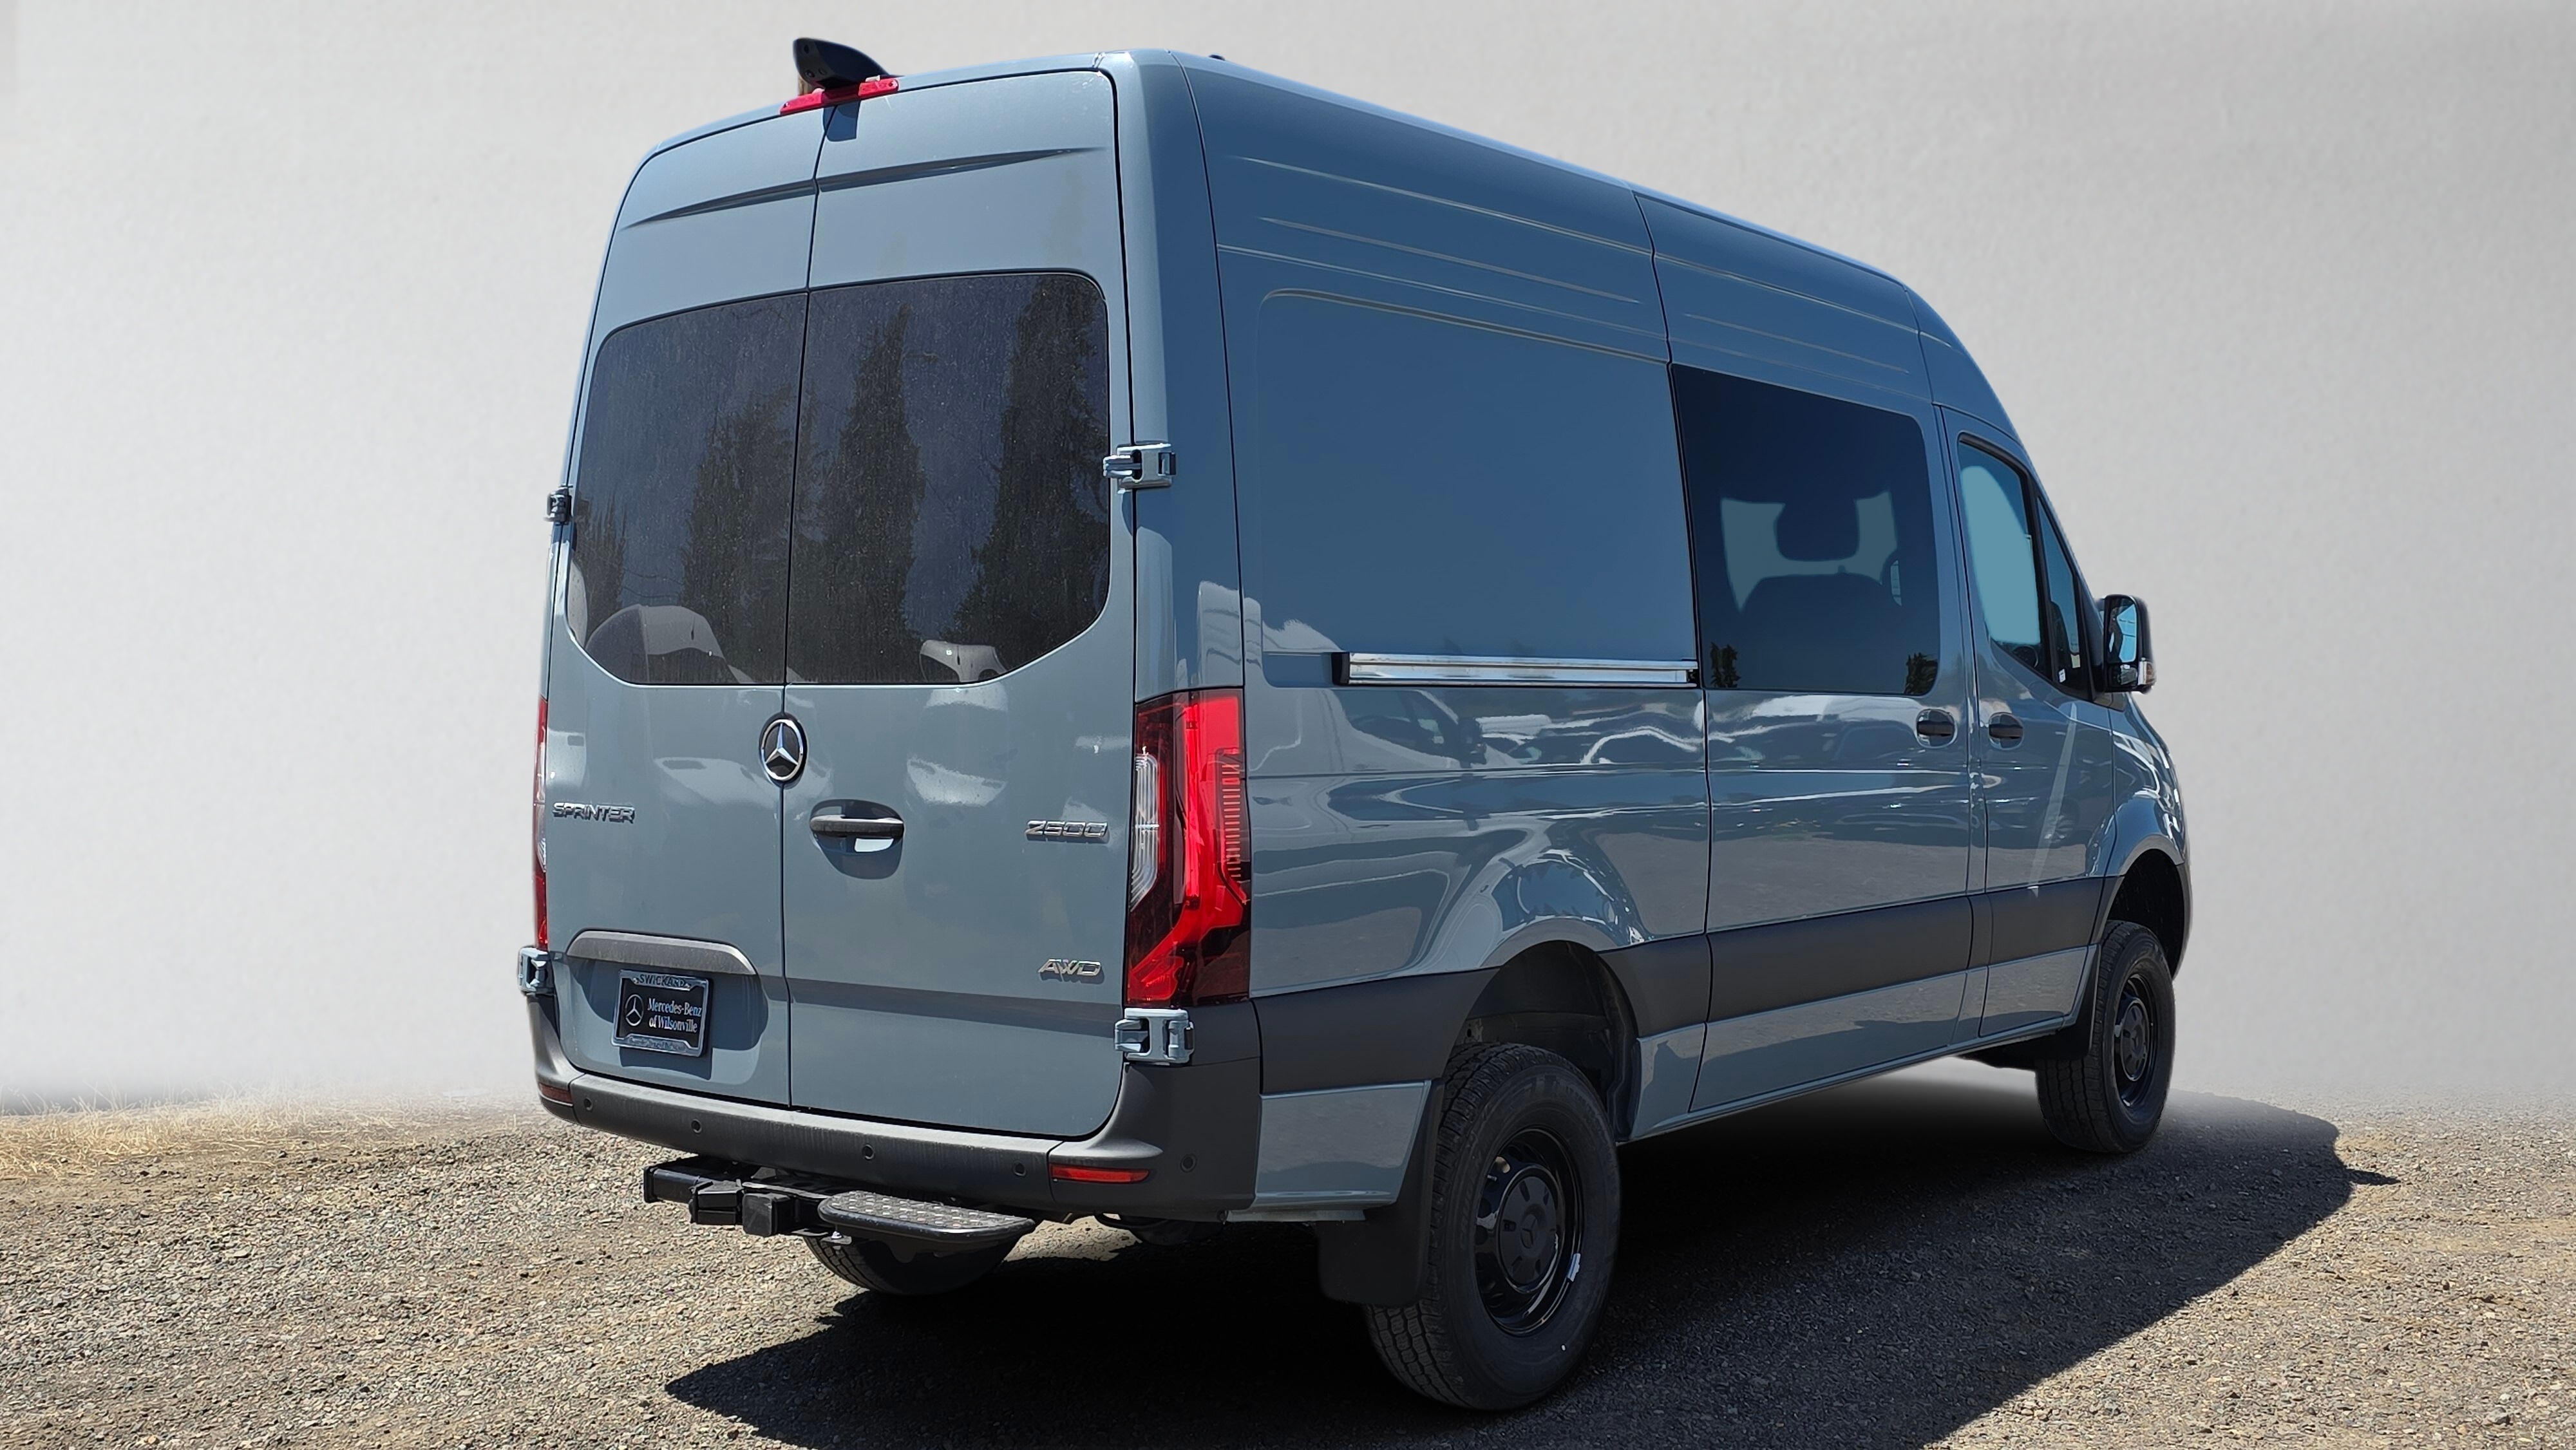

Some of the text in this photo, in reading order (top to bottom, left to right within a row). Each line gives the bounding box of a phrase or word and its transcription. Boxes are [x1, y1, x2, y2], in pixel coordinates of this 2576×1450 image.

[553, 802, 635, 822] SPRINTER
[1025, 820, 1108, 838] 2500
[1037, 959, 1101, 976] AWD
[638, 974, 685, 987] SWICKARD
[647, 997, 702, 1017] Mercedes-Benz
[649, 1015, 698, 1033] of Wilsonville
